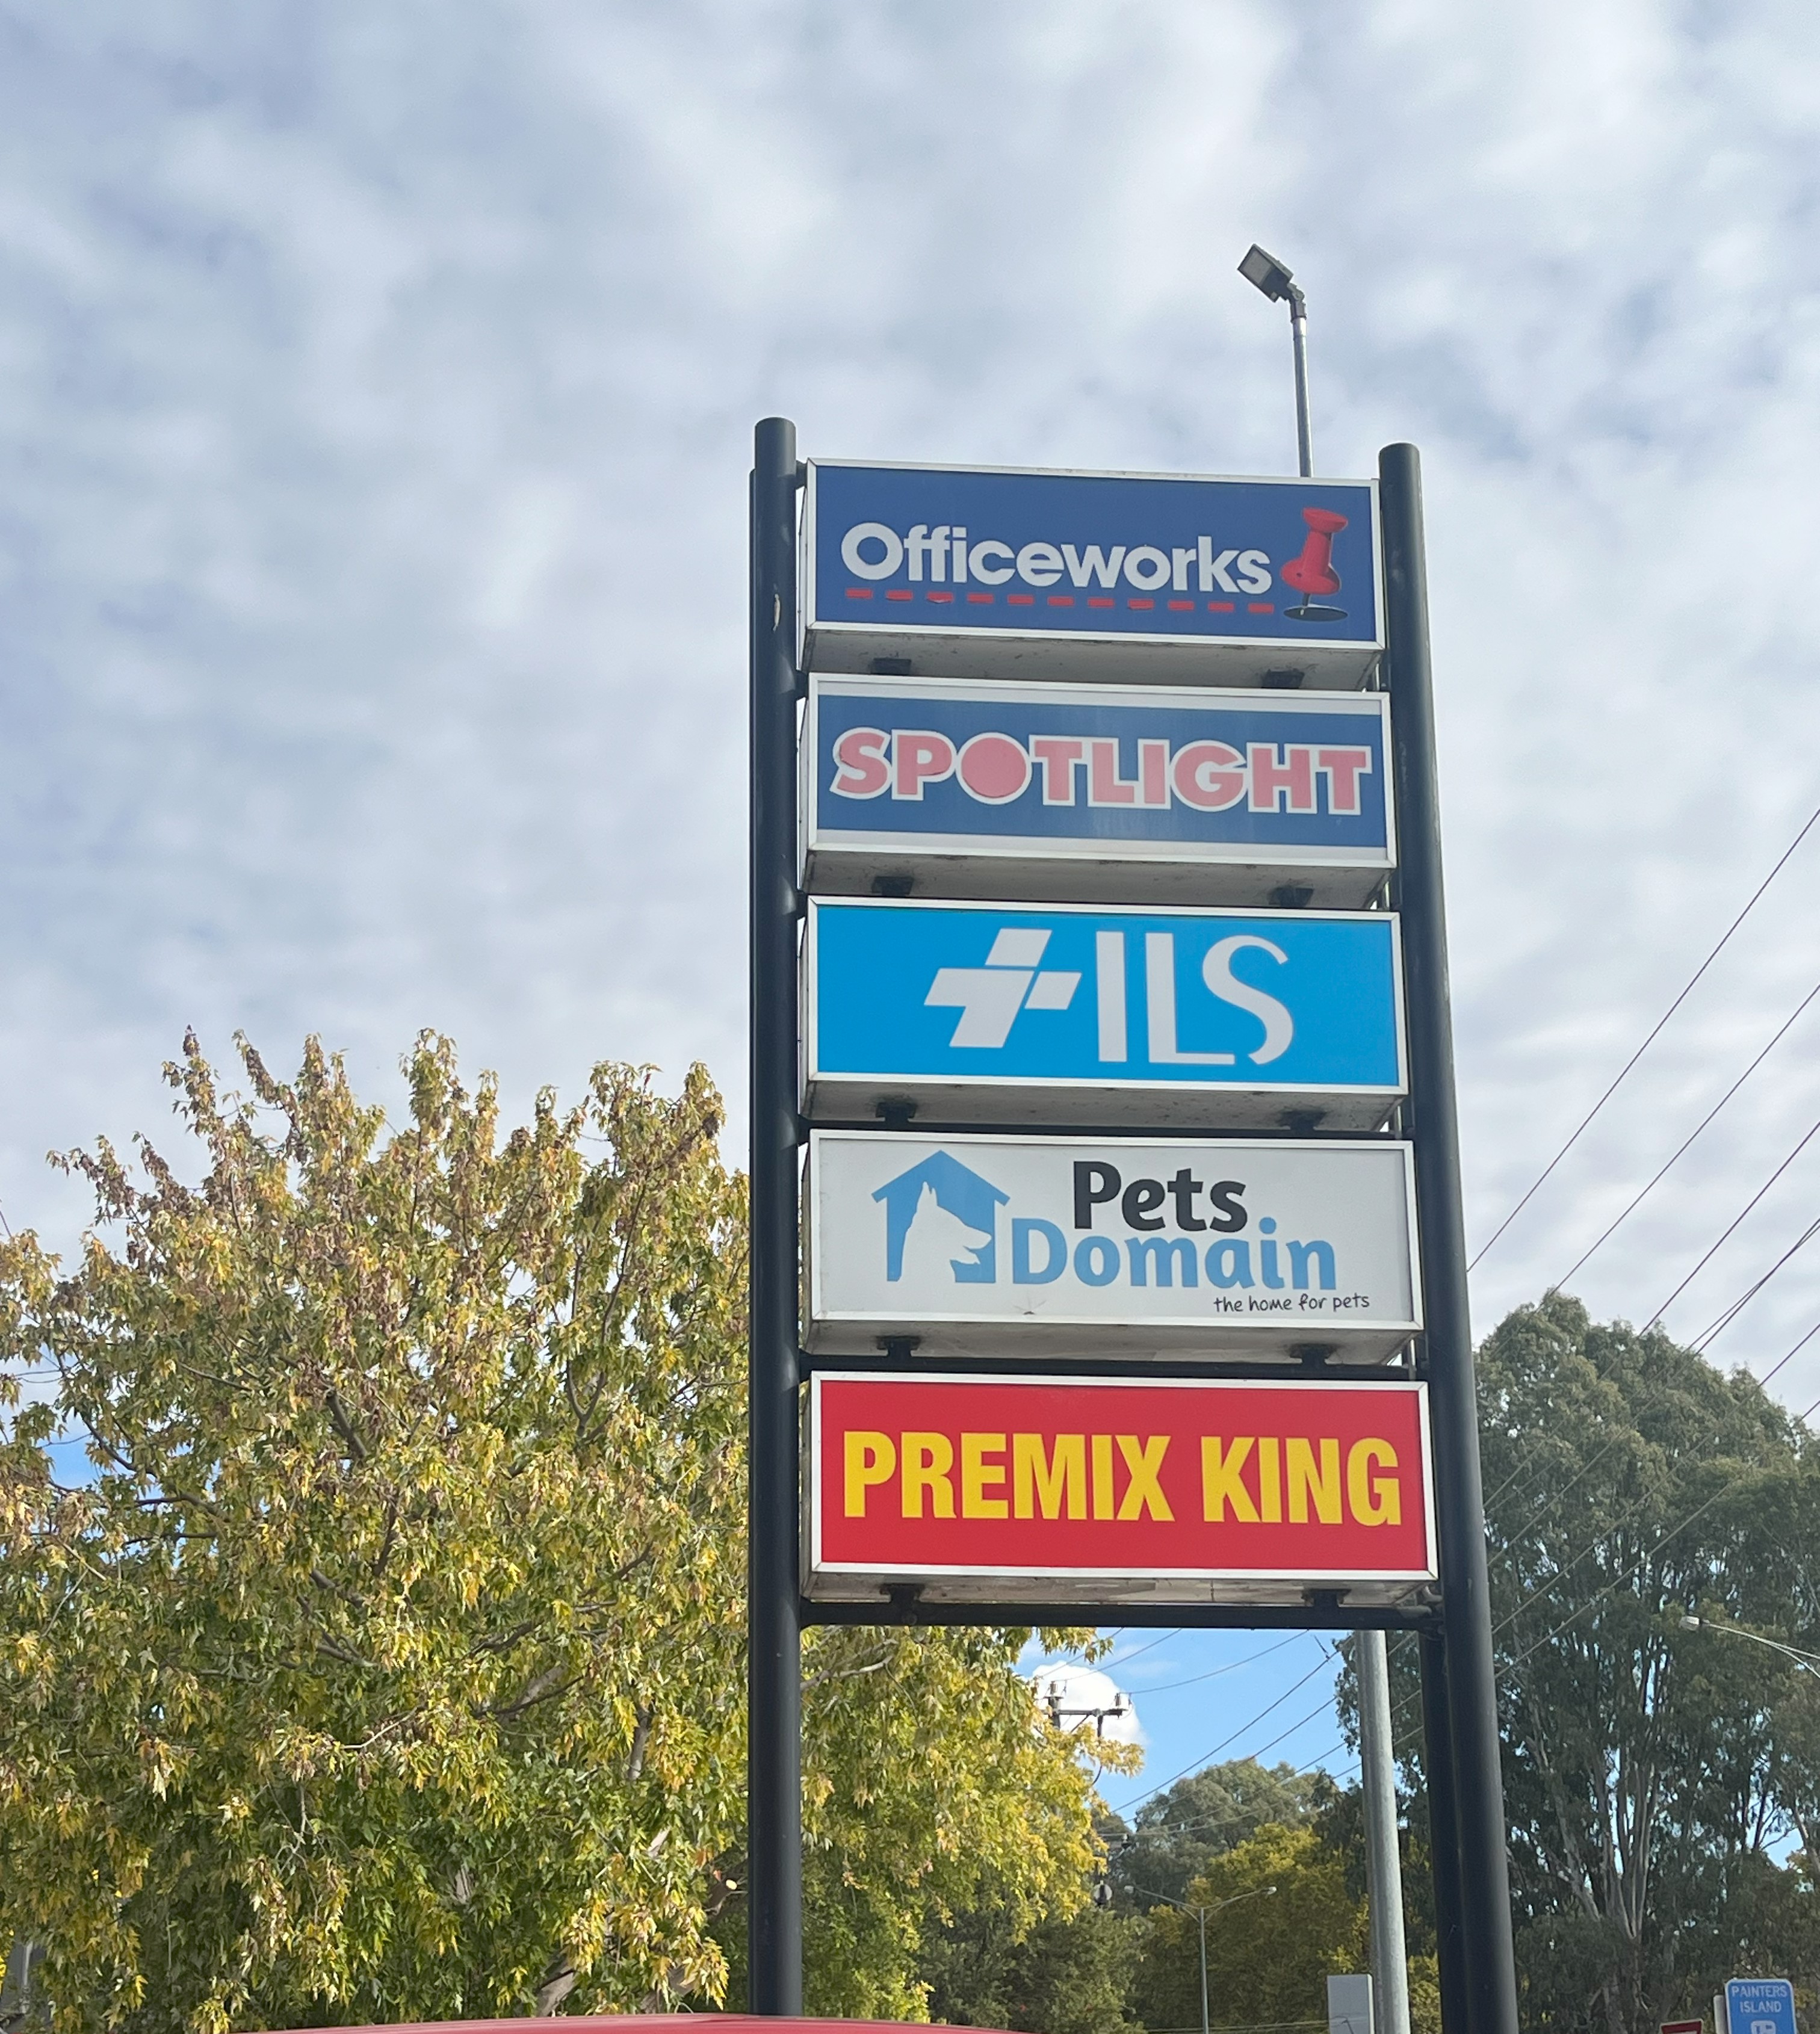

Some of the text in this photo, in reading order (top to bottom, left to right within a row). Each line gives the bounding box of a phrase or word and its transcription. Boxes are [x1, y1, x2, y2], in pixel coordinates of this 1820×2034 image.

[841, 522, 1272, 595] Officeworks
[830, 727, 1372, 815] SPOTLIGHT
[1095, 930, 1294, 1065] ILS
[1073, 1160, 1248, 1233] Pets
[1012, 1217, 1337, 1291] Domain
[1213, 1292, 1370, 1312] the home for pets
[843, 1430, 1402, 1526] PREMIX KING
[1732, 1985, 1788, 1998] PAINTERS
[1739, 2001, 1782, 2014] ISLAND
